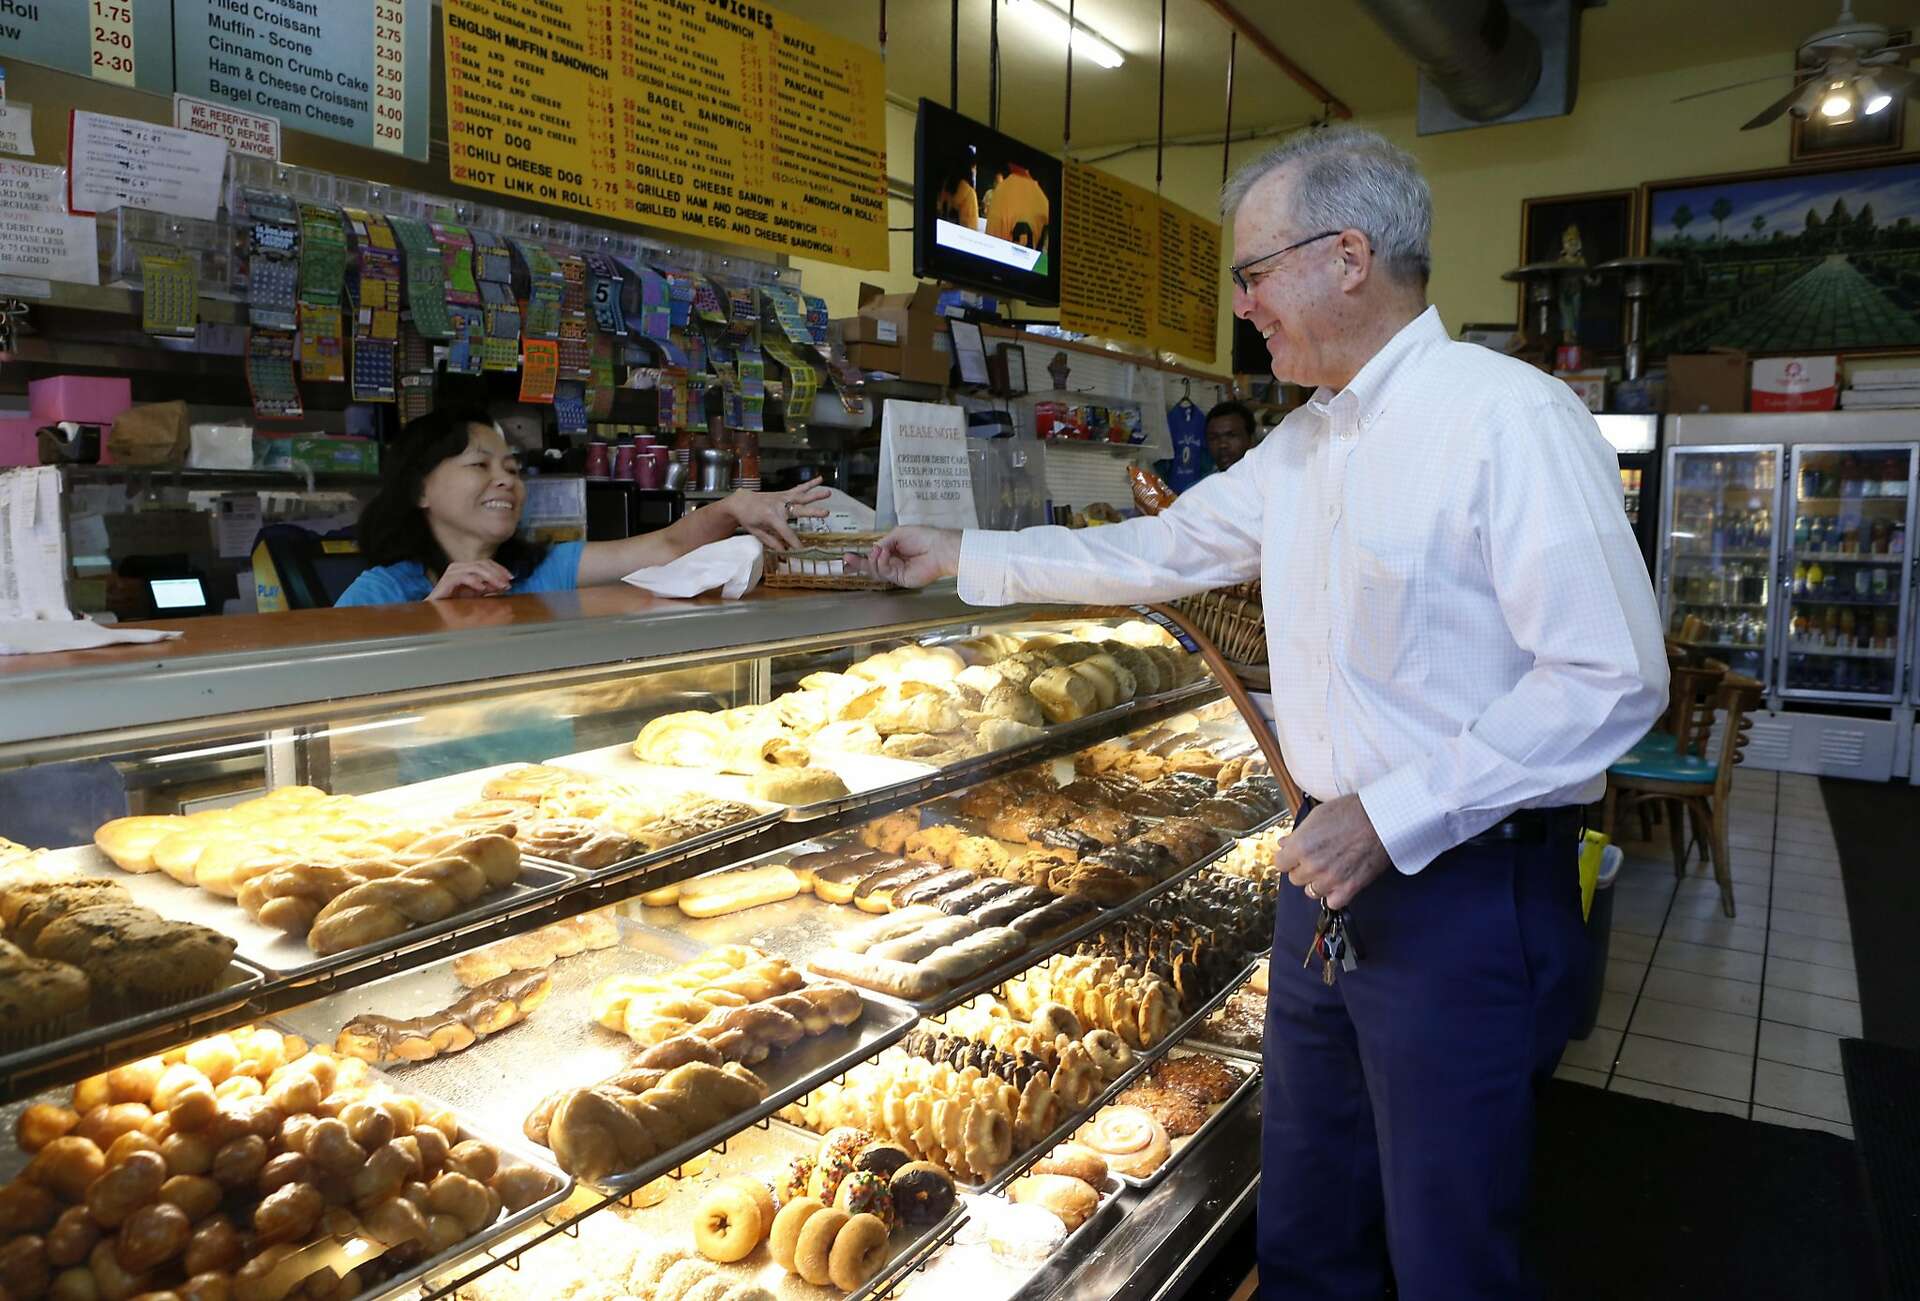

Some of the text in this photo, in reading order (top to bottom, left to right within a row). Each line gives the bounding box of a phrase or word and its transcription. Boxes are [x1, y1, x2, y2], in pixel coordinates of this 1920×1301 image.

[1, 0, 38, 21] Roll
[94, 2, 131, 23] 1.75
[208, 0, 321, 38] illed Croissant
[376, 6, 402, 24] 2.30
[95, 27, 131, 49] 2.30
[208, 13, 255, 39] Muffin
[269, 31, 313, 56] Scone
[376, 25, 401, 43] 2.75
[705, 11, 754, 41] SANDWICH
[376, 45, 402, 63] 2.30
[449, 13, 608, 80] ENGLISH MUFFIN SANDWICH
[783, 34, 816, 56] WAFFLE
[94, 51, 133, 73] 2.30
[209, 35, 369, 92] Cinnamon Crumb Cake
[376, 65, 402, 82] 2.50
[209, 56, 368, 112] Ham & Cheese Croissant
[376, 84, 402, 101] 2.30
[784, 77, 824, 101] PANCAKE
[209, 79, 354, 128] Bagel Cream Cheese
[377, 104, 402, 121] 4.00
[647, 91, 686, 114] BAGEL
[698, 108, 752, 134] SANDWICH
[191, 105, 270, 133] WE RESERVE THE
[191, 117, 218, 131] RIGHT
[222, 124, 233, 136] TO
[237, 128, 270, 144] REFUSE
[376, 123, 402, 140] 2.90
[466, 121, 494, 140] HOT
[504, 132, 532, 151] DOG
[506, 155, 553, 180] CHEESE
[557, 168, 583, 186] DOG
[636, 163, 684, 186] GRILLED
[692, 178, 733, 197] CHEESE
[468, 168, 496, 185] HOT
[504, 175, 534, 195] LINK
[540, 184, 557, 200] ON
[562, 189, 593, 208] ROLL
[636, 182, 681, 203] GRILLED
[686, 194, 708, 208] HAM
[713, 200, 732, 214] AND
[735, 206, 769, 223] CHEESE
[773, 215, 817, 234] SANDWICH
[635, 201, 677, 218] GRILLED
[731, 221, 751, 235] AND
[754, 227, 788, 244] CHEESE
[790, 236, 833, 254] SANDWICH
[596, 283, 609, 303] 5
